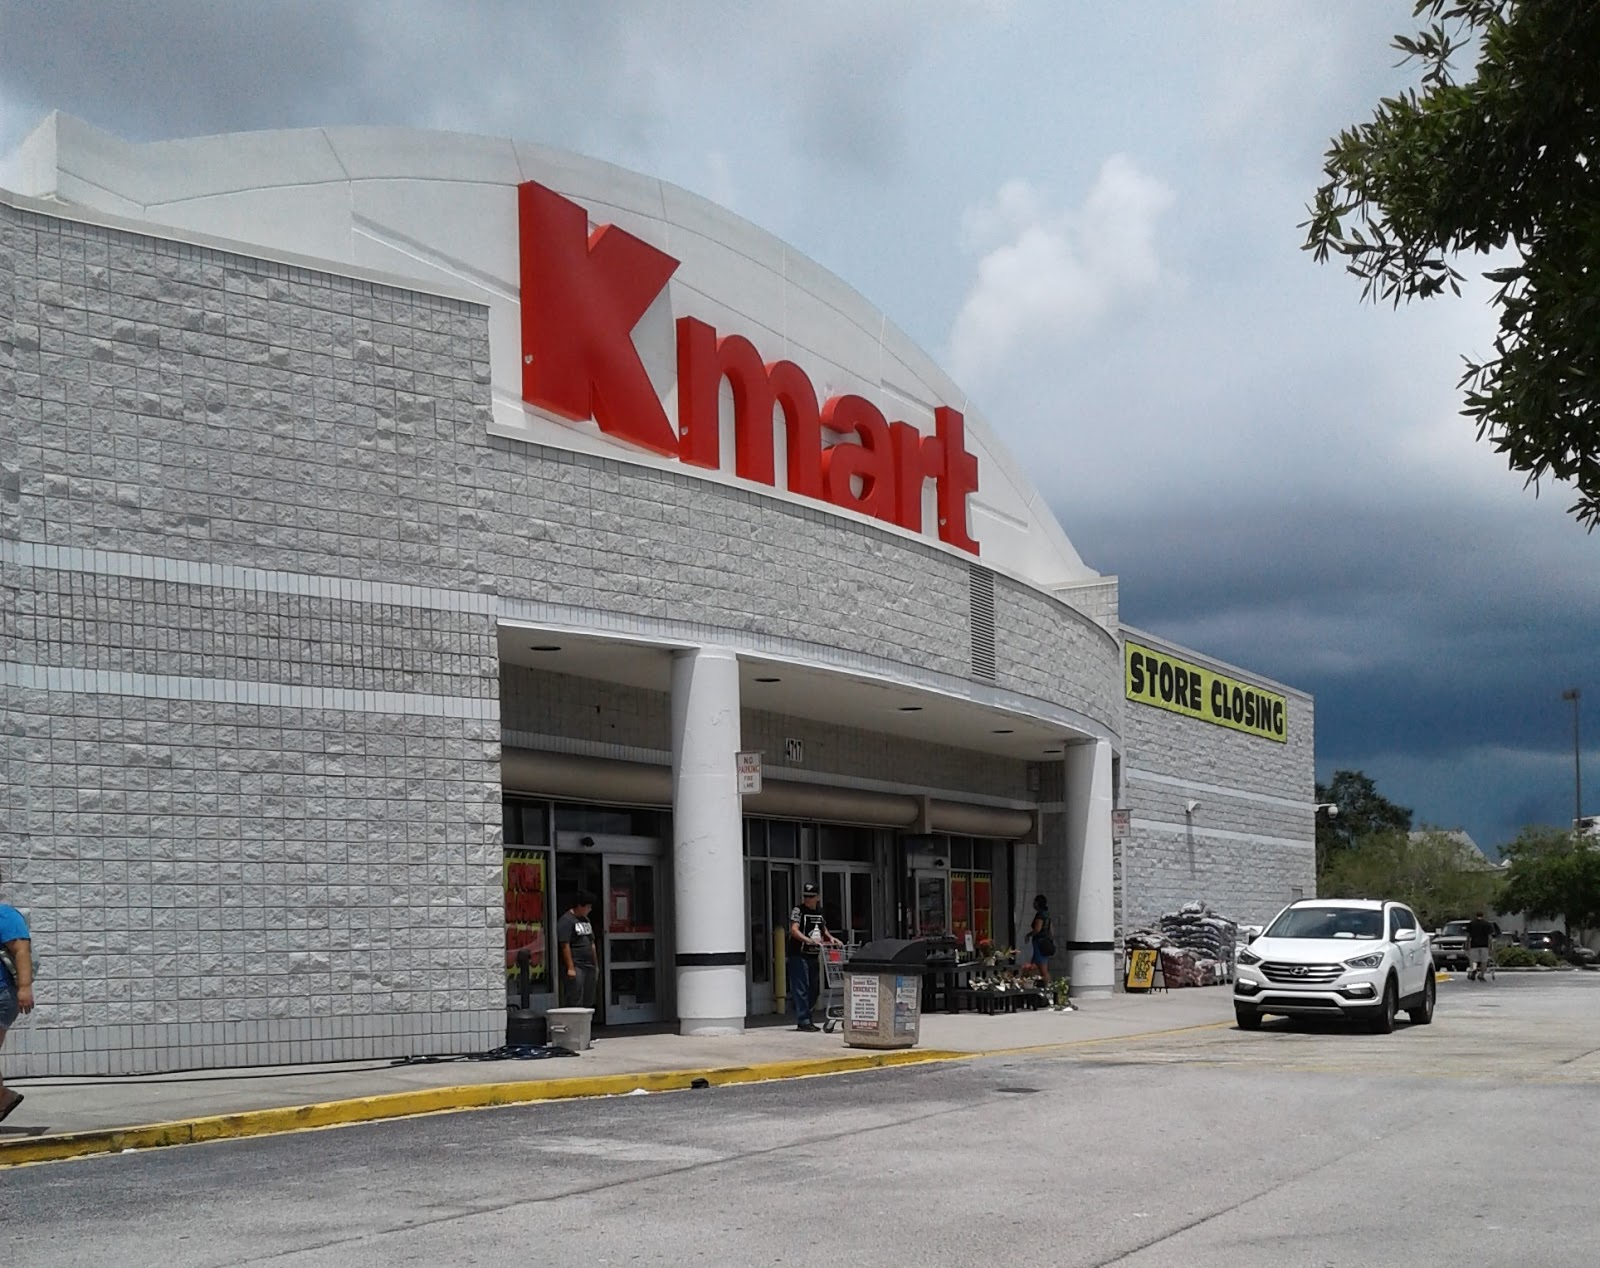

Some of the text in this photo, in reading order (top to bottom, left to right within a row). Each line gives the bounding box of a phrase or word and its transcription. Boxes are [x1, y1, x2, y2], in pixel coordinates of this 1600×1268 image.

[518, 180, 980, 557] Kmart
[1130, 651, 1284, 735] STORE CLOSING
[738, 764, 760, 774] PARKING
[743, 756, 754, 765] NO
